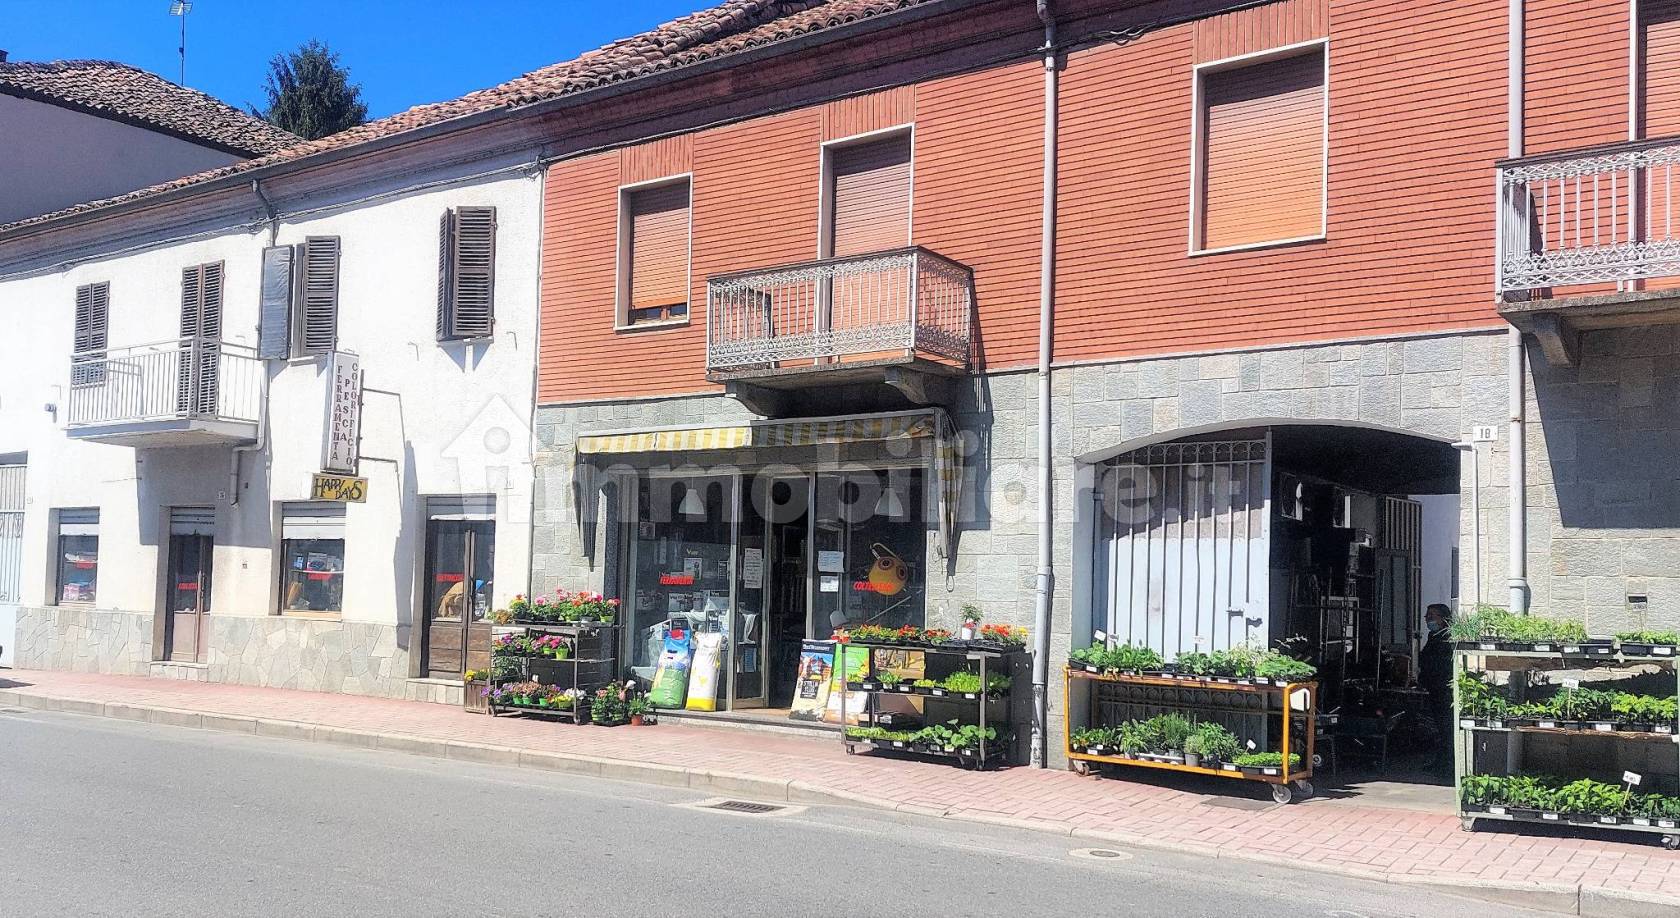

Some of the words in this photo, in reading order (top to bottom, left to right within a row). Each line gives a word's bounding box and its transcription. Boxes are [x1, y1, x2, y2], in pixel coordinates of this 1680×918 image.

[332, 366, 342, 460] FERRAMENTA
[341, 379, 350, 441] PESCA
[346, 363, 358, 465] COLORIFICIO
[1480, 428, 1491, 438] 18
[314, 478, 344, 498] HAPPY
[335, 480, 363, 500] DAYS
